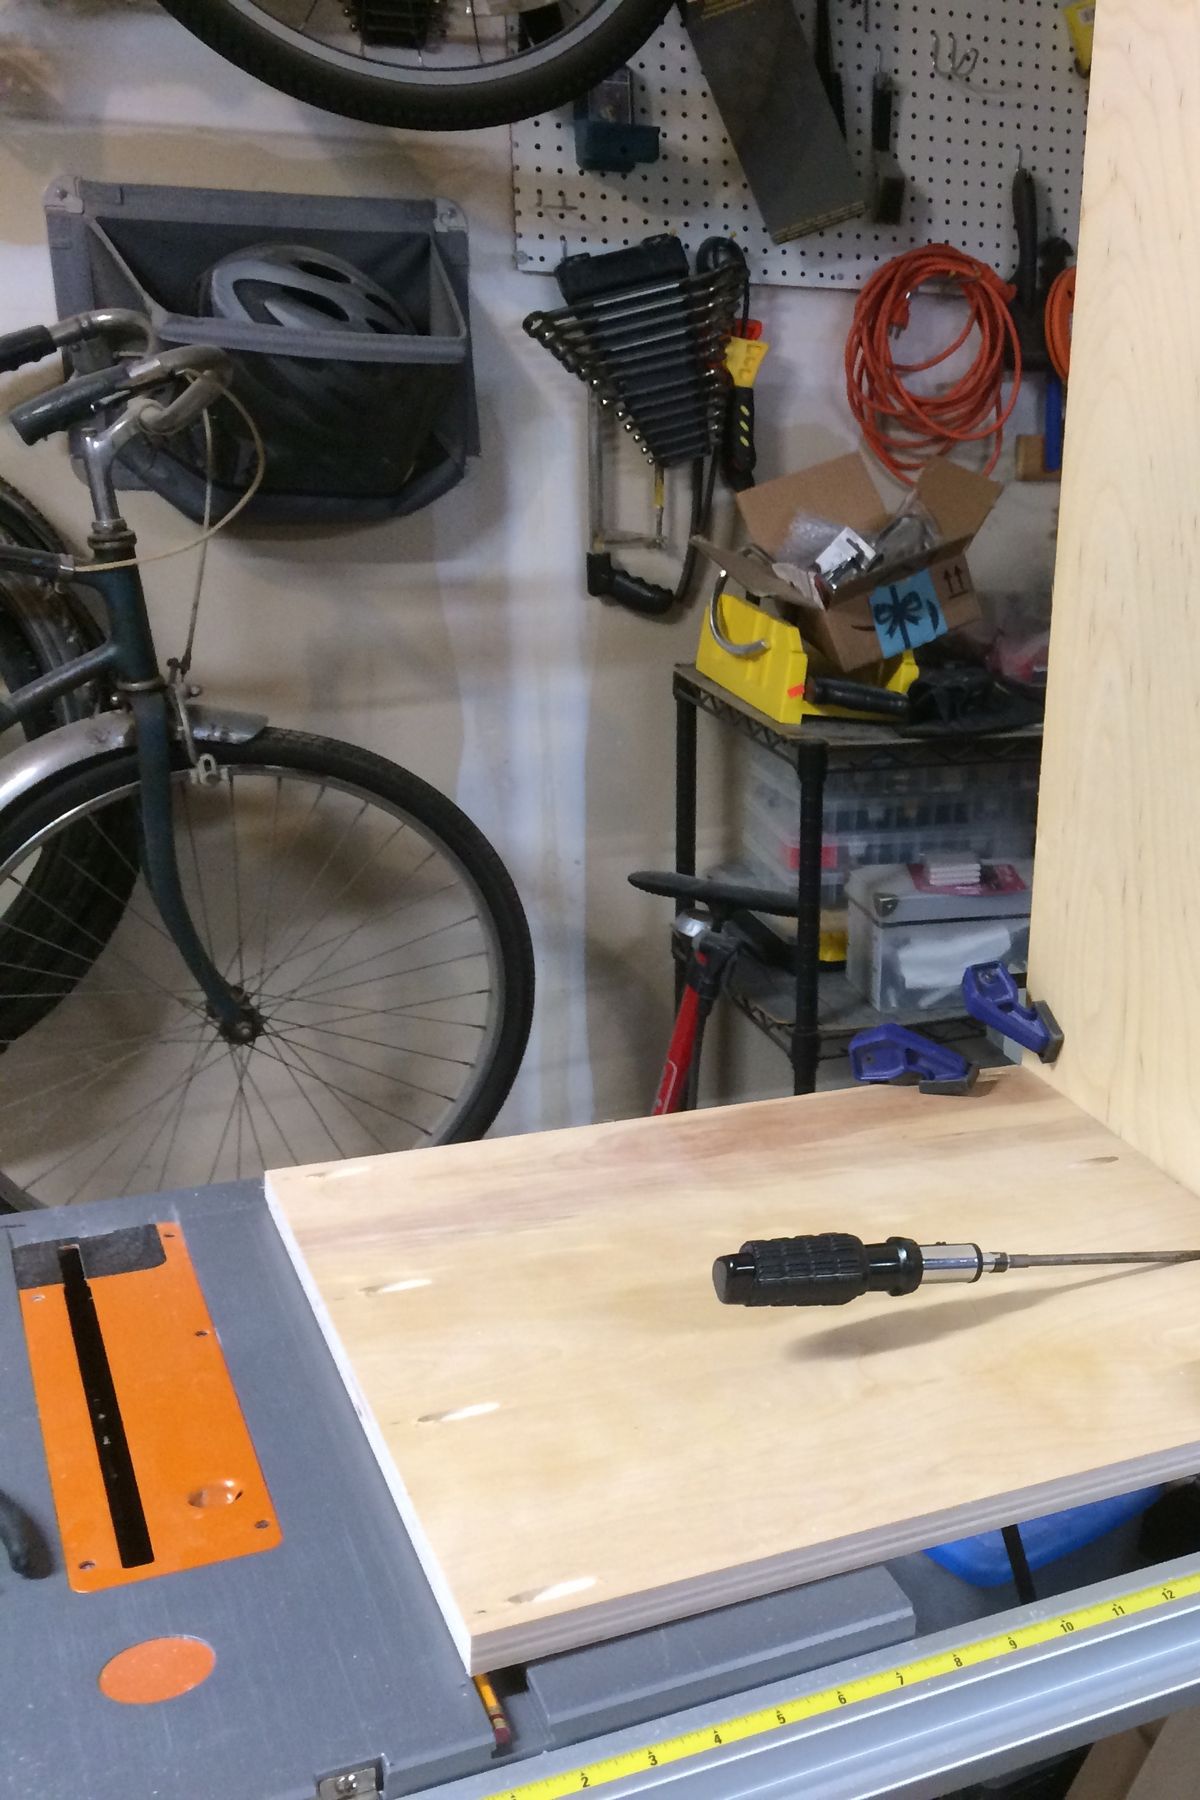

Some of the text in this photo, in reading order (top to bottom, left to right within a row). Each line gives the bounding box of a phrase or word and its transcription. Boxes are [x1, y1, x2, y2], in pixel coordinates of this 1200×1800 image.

[581, 1776, 590, 1787] 2
[649, 1755, 658, 1766] 3
[714, 1734, 722, 1745] 4
[776, 1713, 786, 1724] 5
[838, 1694, 847, 1705] 6
[896, 1675, 904, 1685] 7
[954, 1657, 963, 1667] 8
[1008, 1639, 1018, 1649] 9
[1060, 1622, 1074, 1633] 10
[1112, 1606, 1126, 1617] 11
[1162, 1590, 1176, 1601] 12
